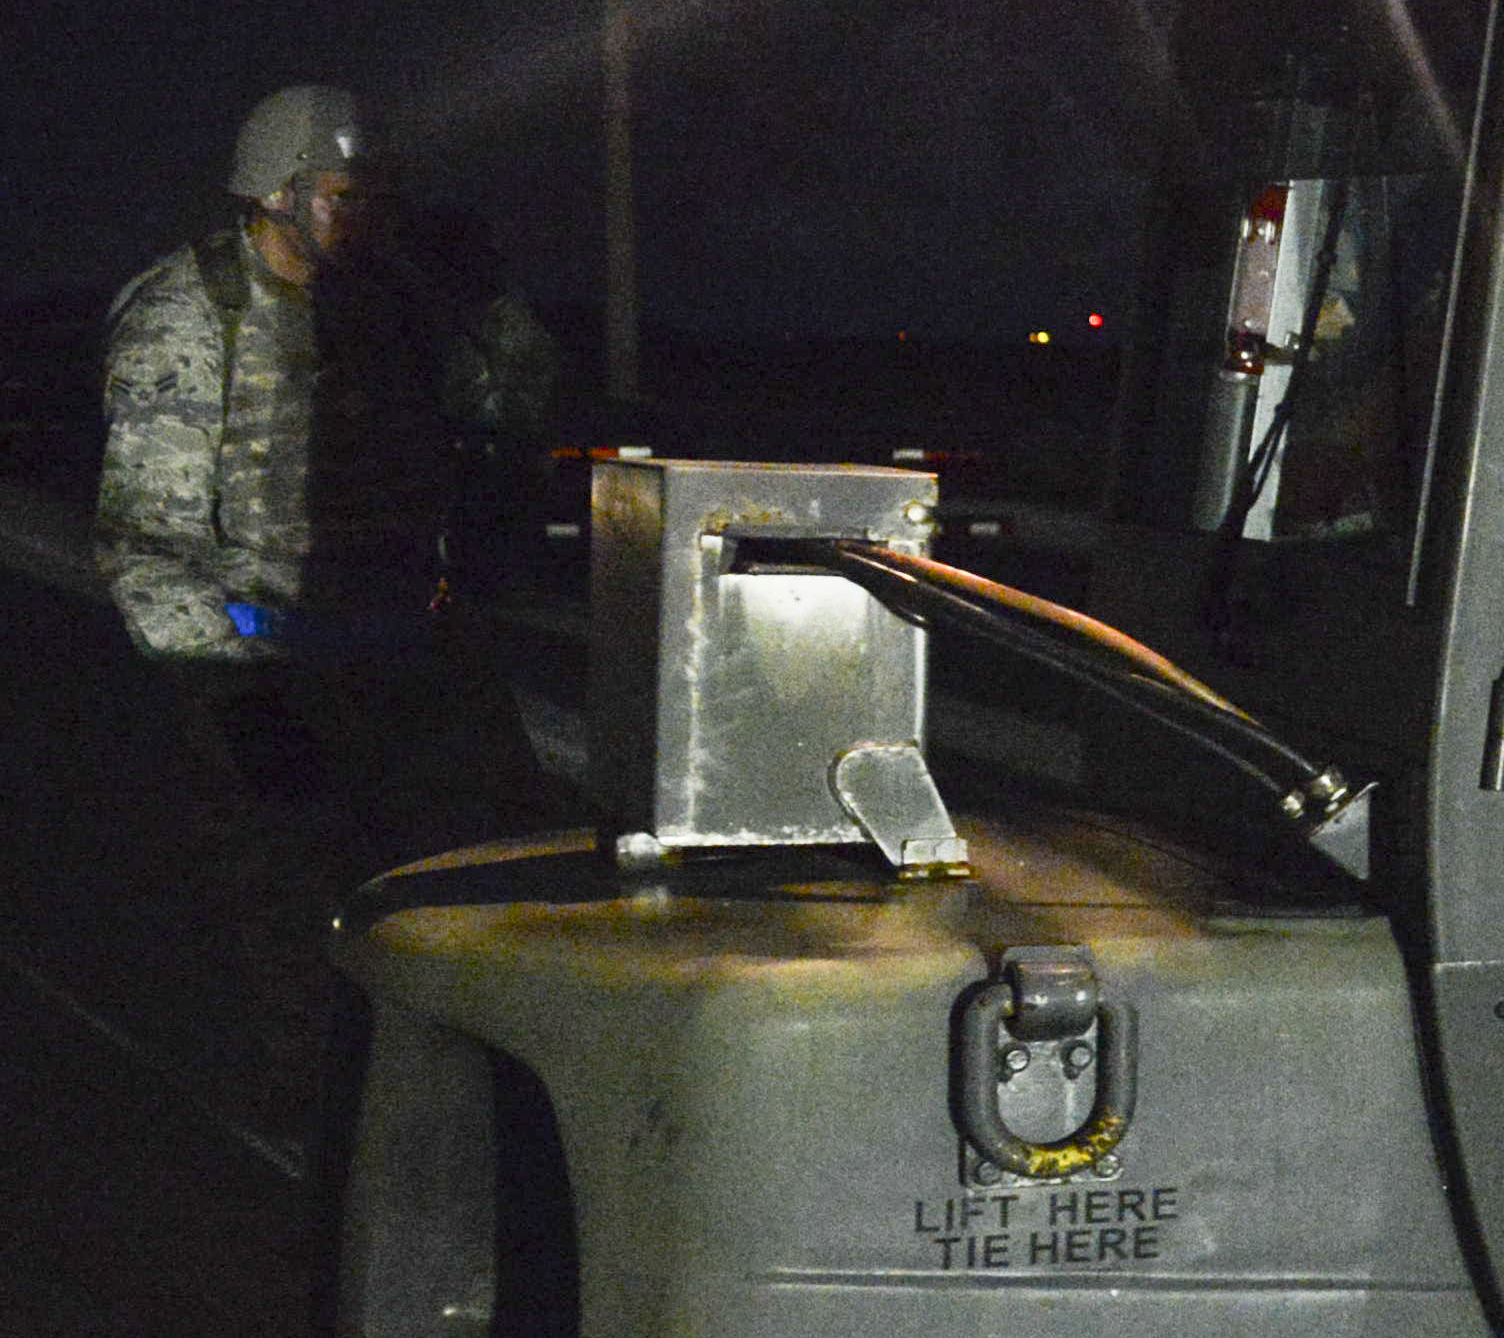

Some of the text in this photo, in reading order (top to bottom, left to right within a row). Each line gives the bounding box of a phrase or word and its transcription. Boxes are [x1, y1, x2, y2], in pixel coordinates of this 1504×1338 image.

[914, 1187, 1178, 1233] LIFT HERE
[935, 1225, 1159, 1269] TIE HERE
